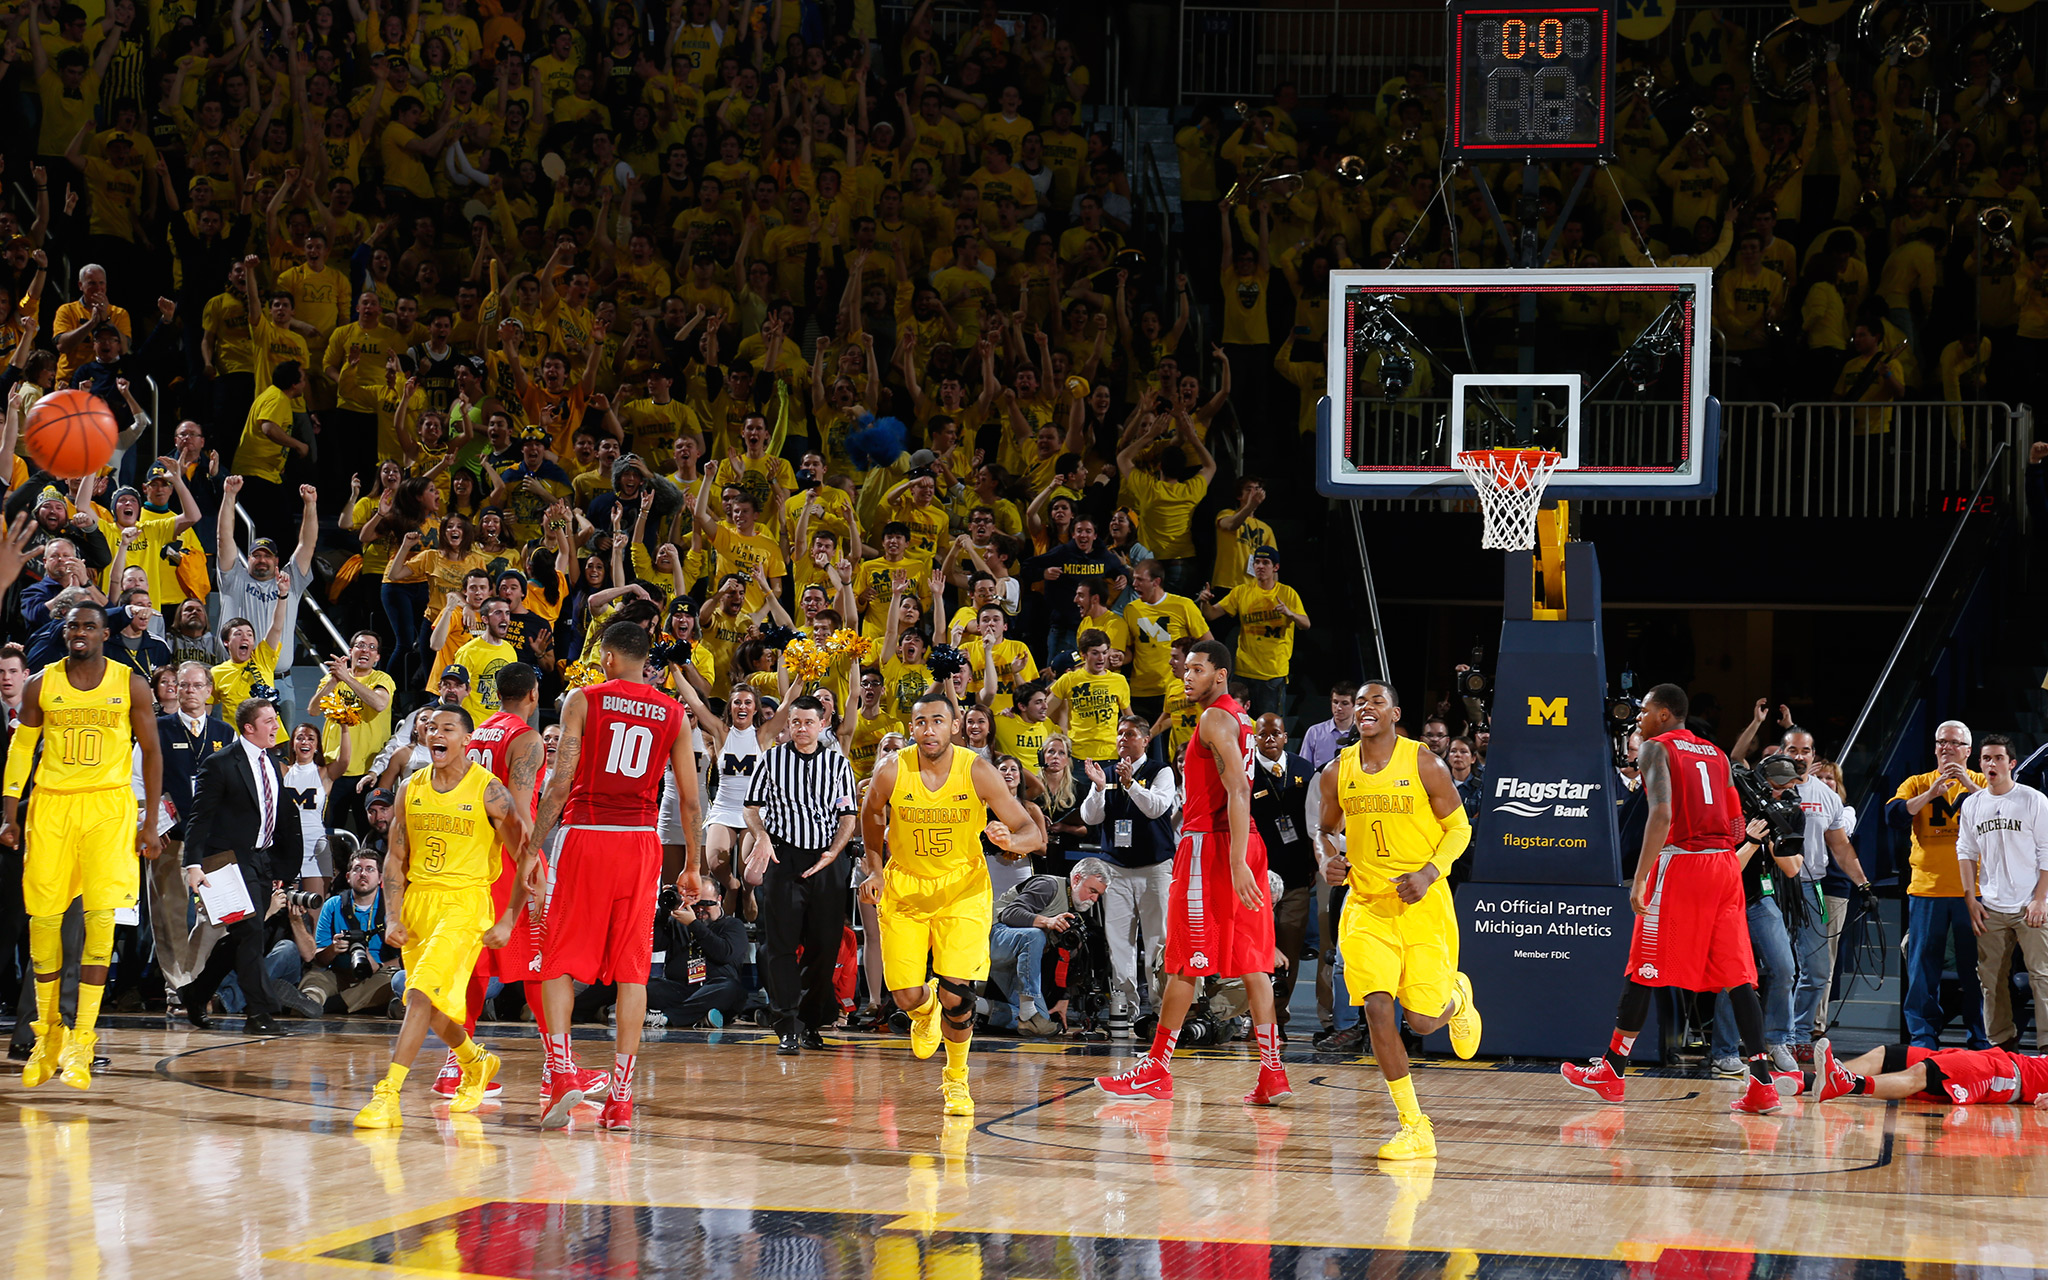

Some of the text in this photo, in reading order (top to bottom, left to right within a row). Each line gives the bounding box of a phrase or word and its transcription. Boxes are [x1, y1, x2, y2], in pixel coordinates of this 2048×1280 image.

[1690, 28, 1722, 67] M
[691, 52, 700, 68] 3
[304, 284, 332, 303] M
[658, 437, 674, 449] M
[919, 537, 934, 552] M
[872, 569, 891, 584] M
[1063, 563, 1105, 575] MICHIGAN
[677, 603, 689, 612] M
[1137, 616, 1171, 643] M
[1264, 625, 1282, 638] M
[997, 681, 1013, 694] M
[1072, 683, 1091, 698] M
[602, 695, 666, 721] BUCKEYES
[1079, 711, 1094, 719] TEAM
[1527, 696, 1568, 726] M
[45, 708, 121, 728] MICHIGAN
[1181, 715, 1197, 727] M
[63, 728, 102, 766] 10
[212, 740, 223, 748] M
[605, 722, 653, 778] 10
[1673, 739, 1718, 757] BUCKEYES
[723, 753, 757, 776] M
[1495, 777, 1595, 803] Flagstar
[1696, 761, 1714, 805] 1
[284, 787, 317, 810] M
[1343, 794, 1414, 817] MICHIGAN
[898, 806, 971, 824] MICHIGAN
[1553, 804, 1589, 818] Bank
[1929, 792, 1970, 827] M
[408, 813, 476, 837] MICHIGAN
[913, 828, 953, 857] 15
[1371, 820, 1390, 857] 1
[1502, 833, 1587, 849] flagstar.com
[424, 836, 447, 873] 3
[1474, 900, 1613, 916] An Official Partner
[1475, 920, 1612, 937] Michigan Athletics
[1514, 950, 1571, 960] Member FDIC
